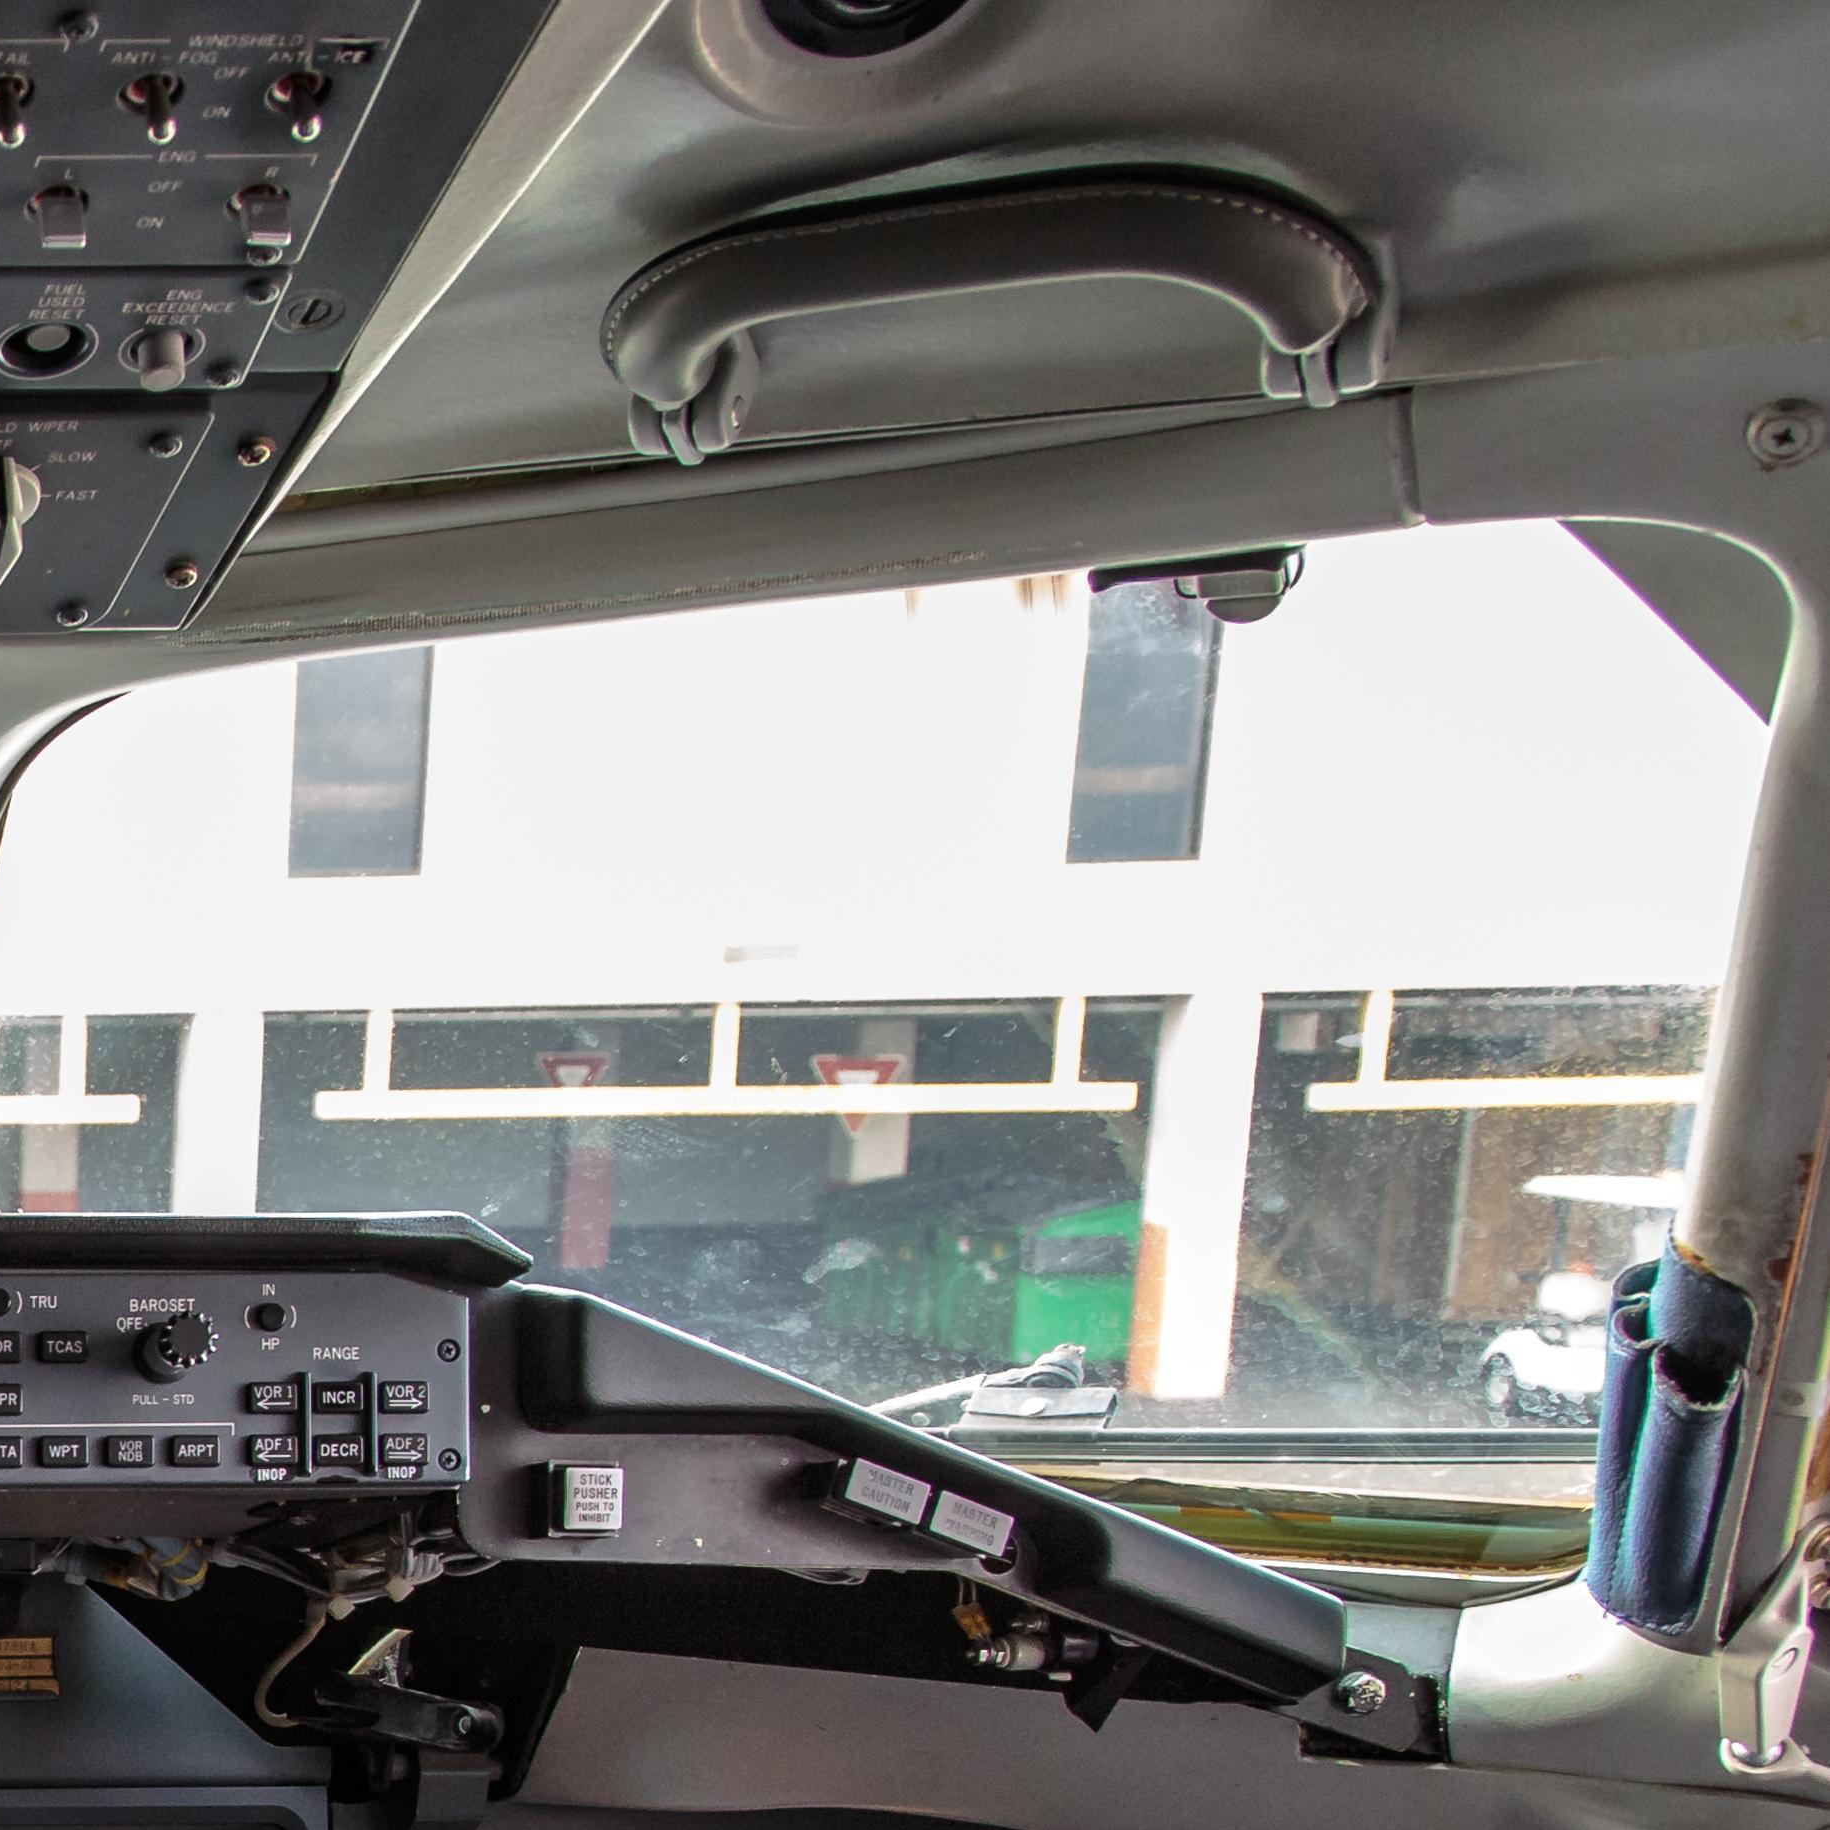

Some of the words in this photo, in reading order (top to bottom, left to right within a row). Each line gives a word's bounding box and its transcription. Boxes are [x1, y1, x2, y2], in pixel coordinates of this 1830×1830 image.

[44, 284, 84, 296] FUEL
[167, 289, 202, 301] ENG
[39, 296, 84, 308] USED
[29, 308, 84, 321] RESET
[146, 314, 200, 326] RESET
[28, 422, 79, 434] WIPER
[129, 1298, 196, 1312] BAROSET
[47, 1340, 83, 1353] TCAS
[312, 1347, 360, 1361] RANGE
[322, 1390, 355, 1403] INCR
[321, 1444, 359, 1457] DECR
[580, 1474, 612, 1485] STICK
[573, 1487, 618, 1499] PUSHER
